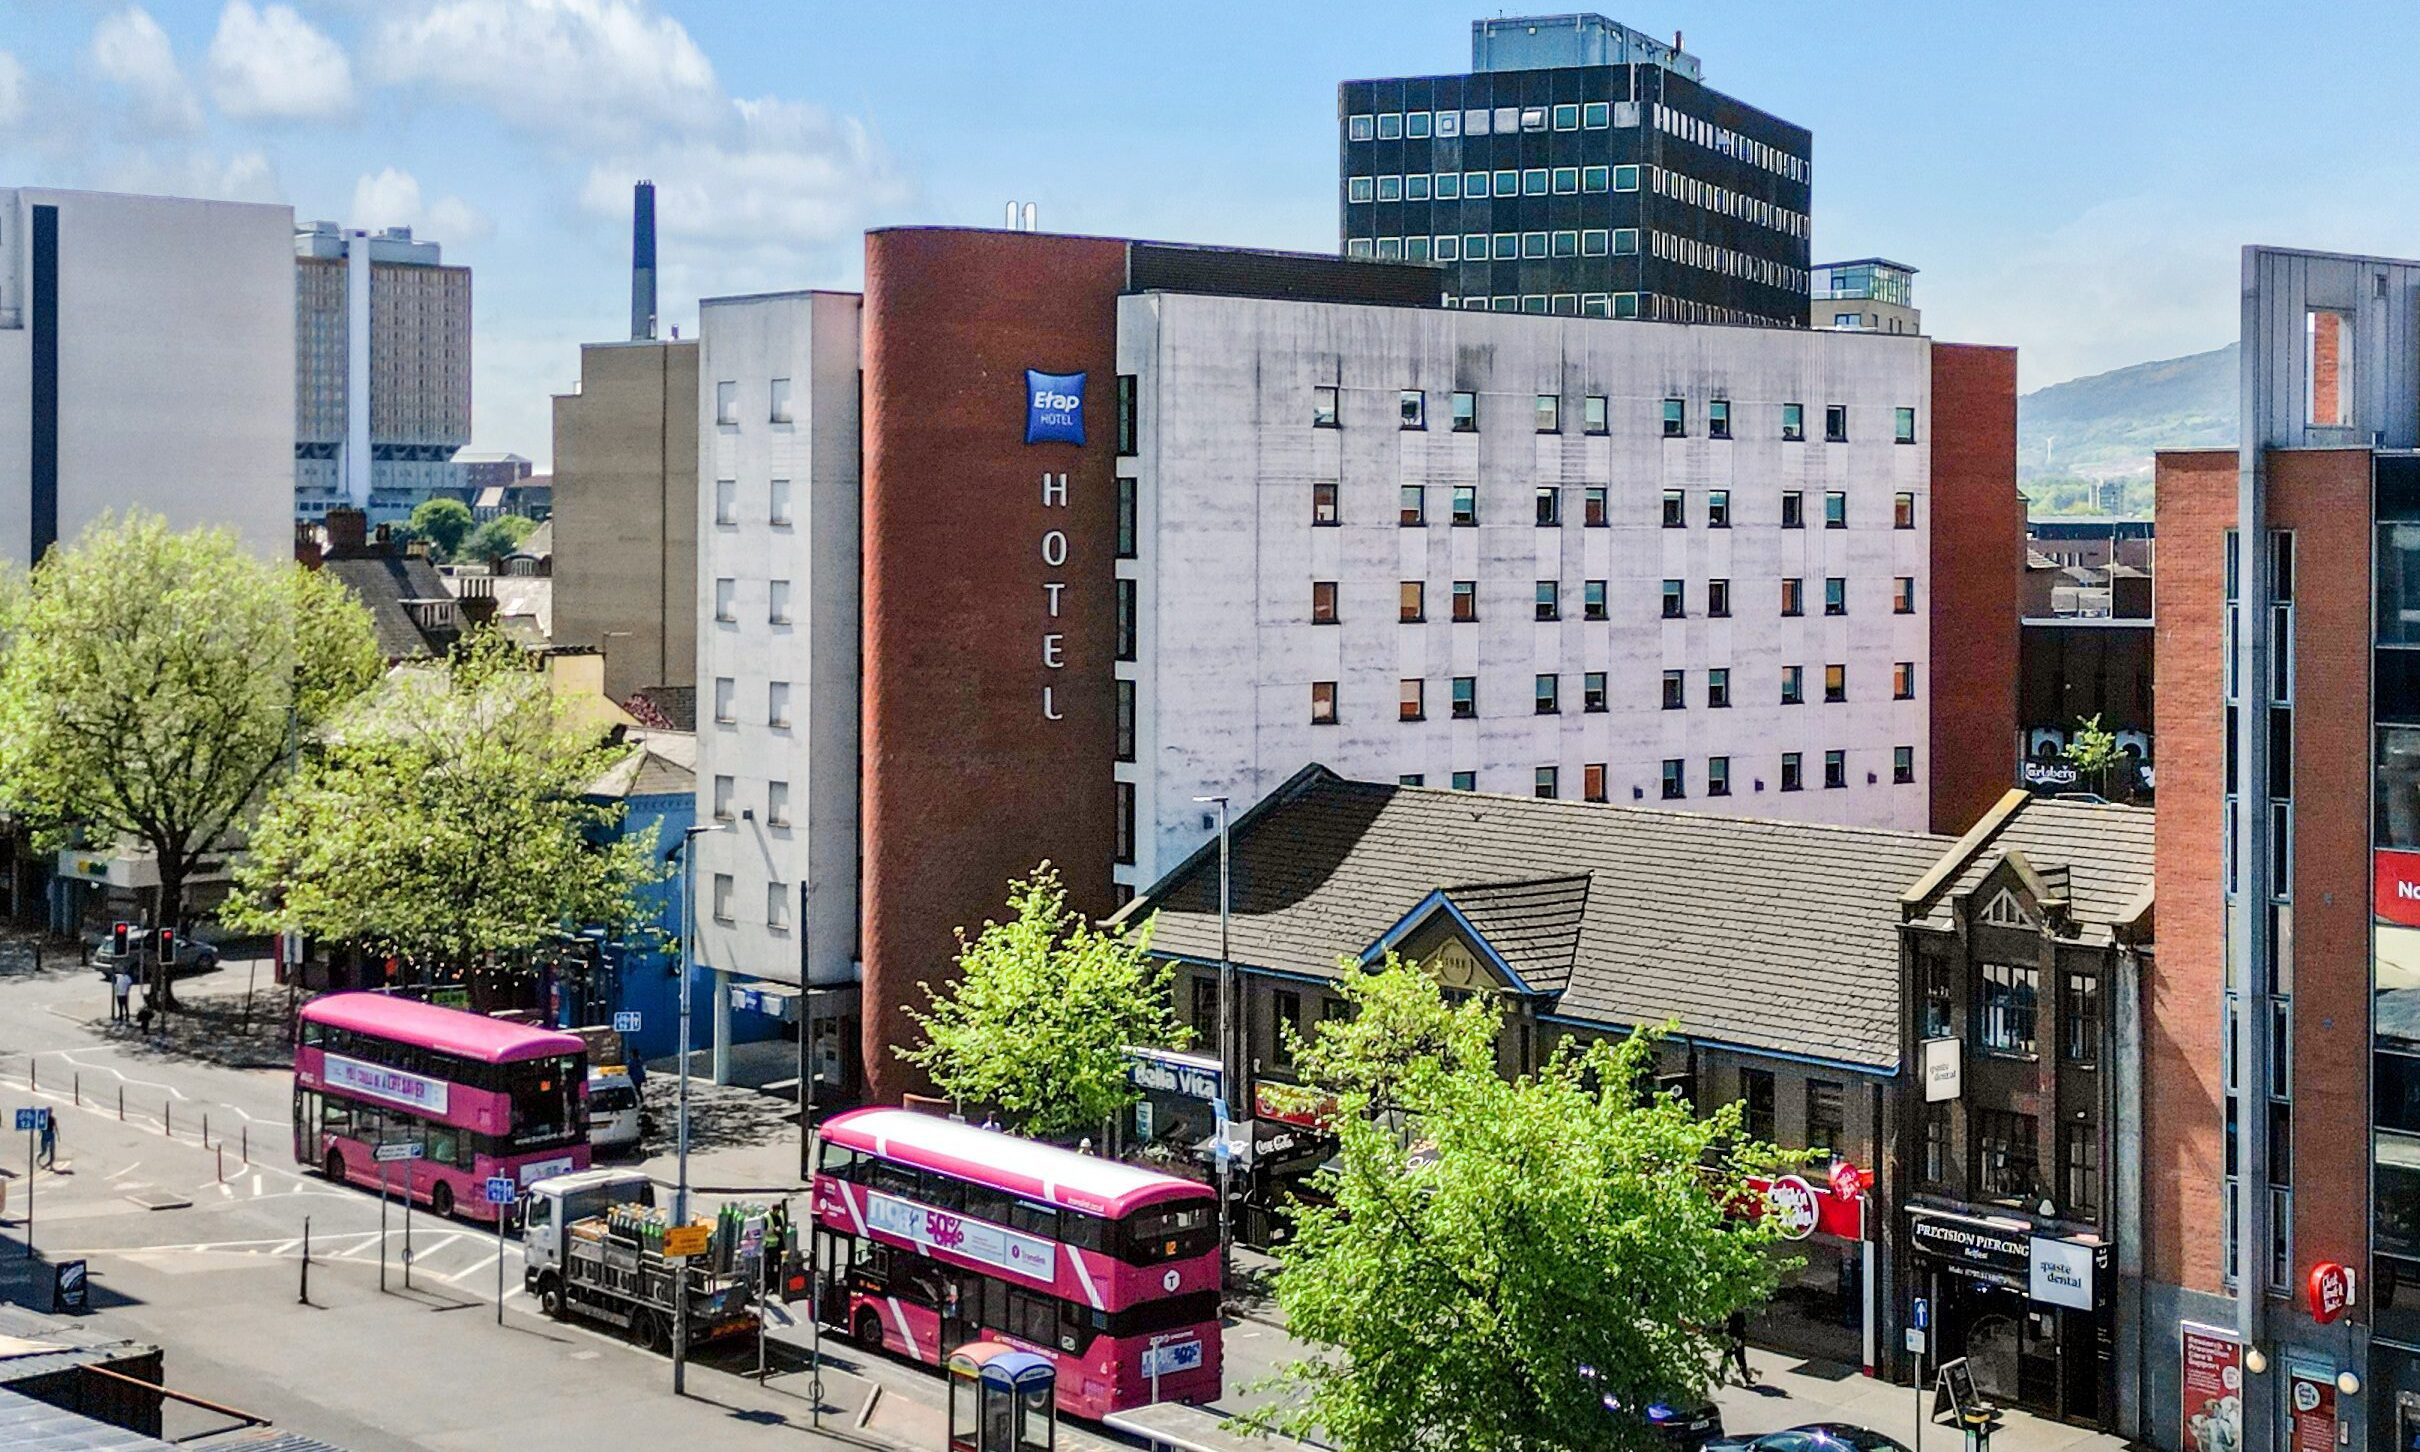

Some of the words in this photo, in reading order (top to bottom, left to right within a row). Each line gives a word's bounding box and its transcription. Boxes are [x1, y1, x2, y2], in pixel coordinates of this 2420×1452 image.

[1033, 390, 1080, 413] Etap
[1040, 411, 1074, 426] HOTEL
[1042, 472, 1068, 720] HOTEL
[2025, 762, 2077, 783] Carlsberg
[1178, 1070, 1217, 1099] Vita
[1916, 1223, 1975, 1246] PRECISION
[1976, 1235, 2030, 1257] PIERCING
[2047, 1272, 2082, 1289] dental
